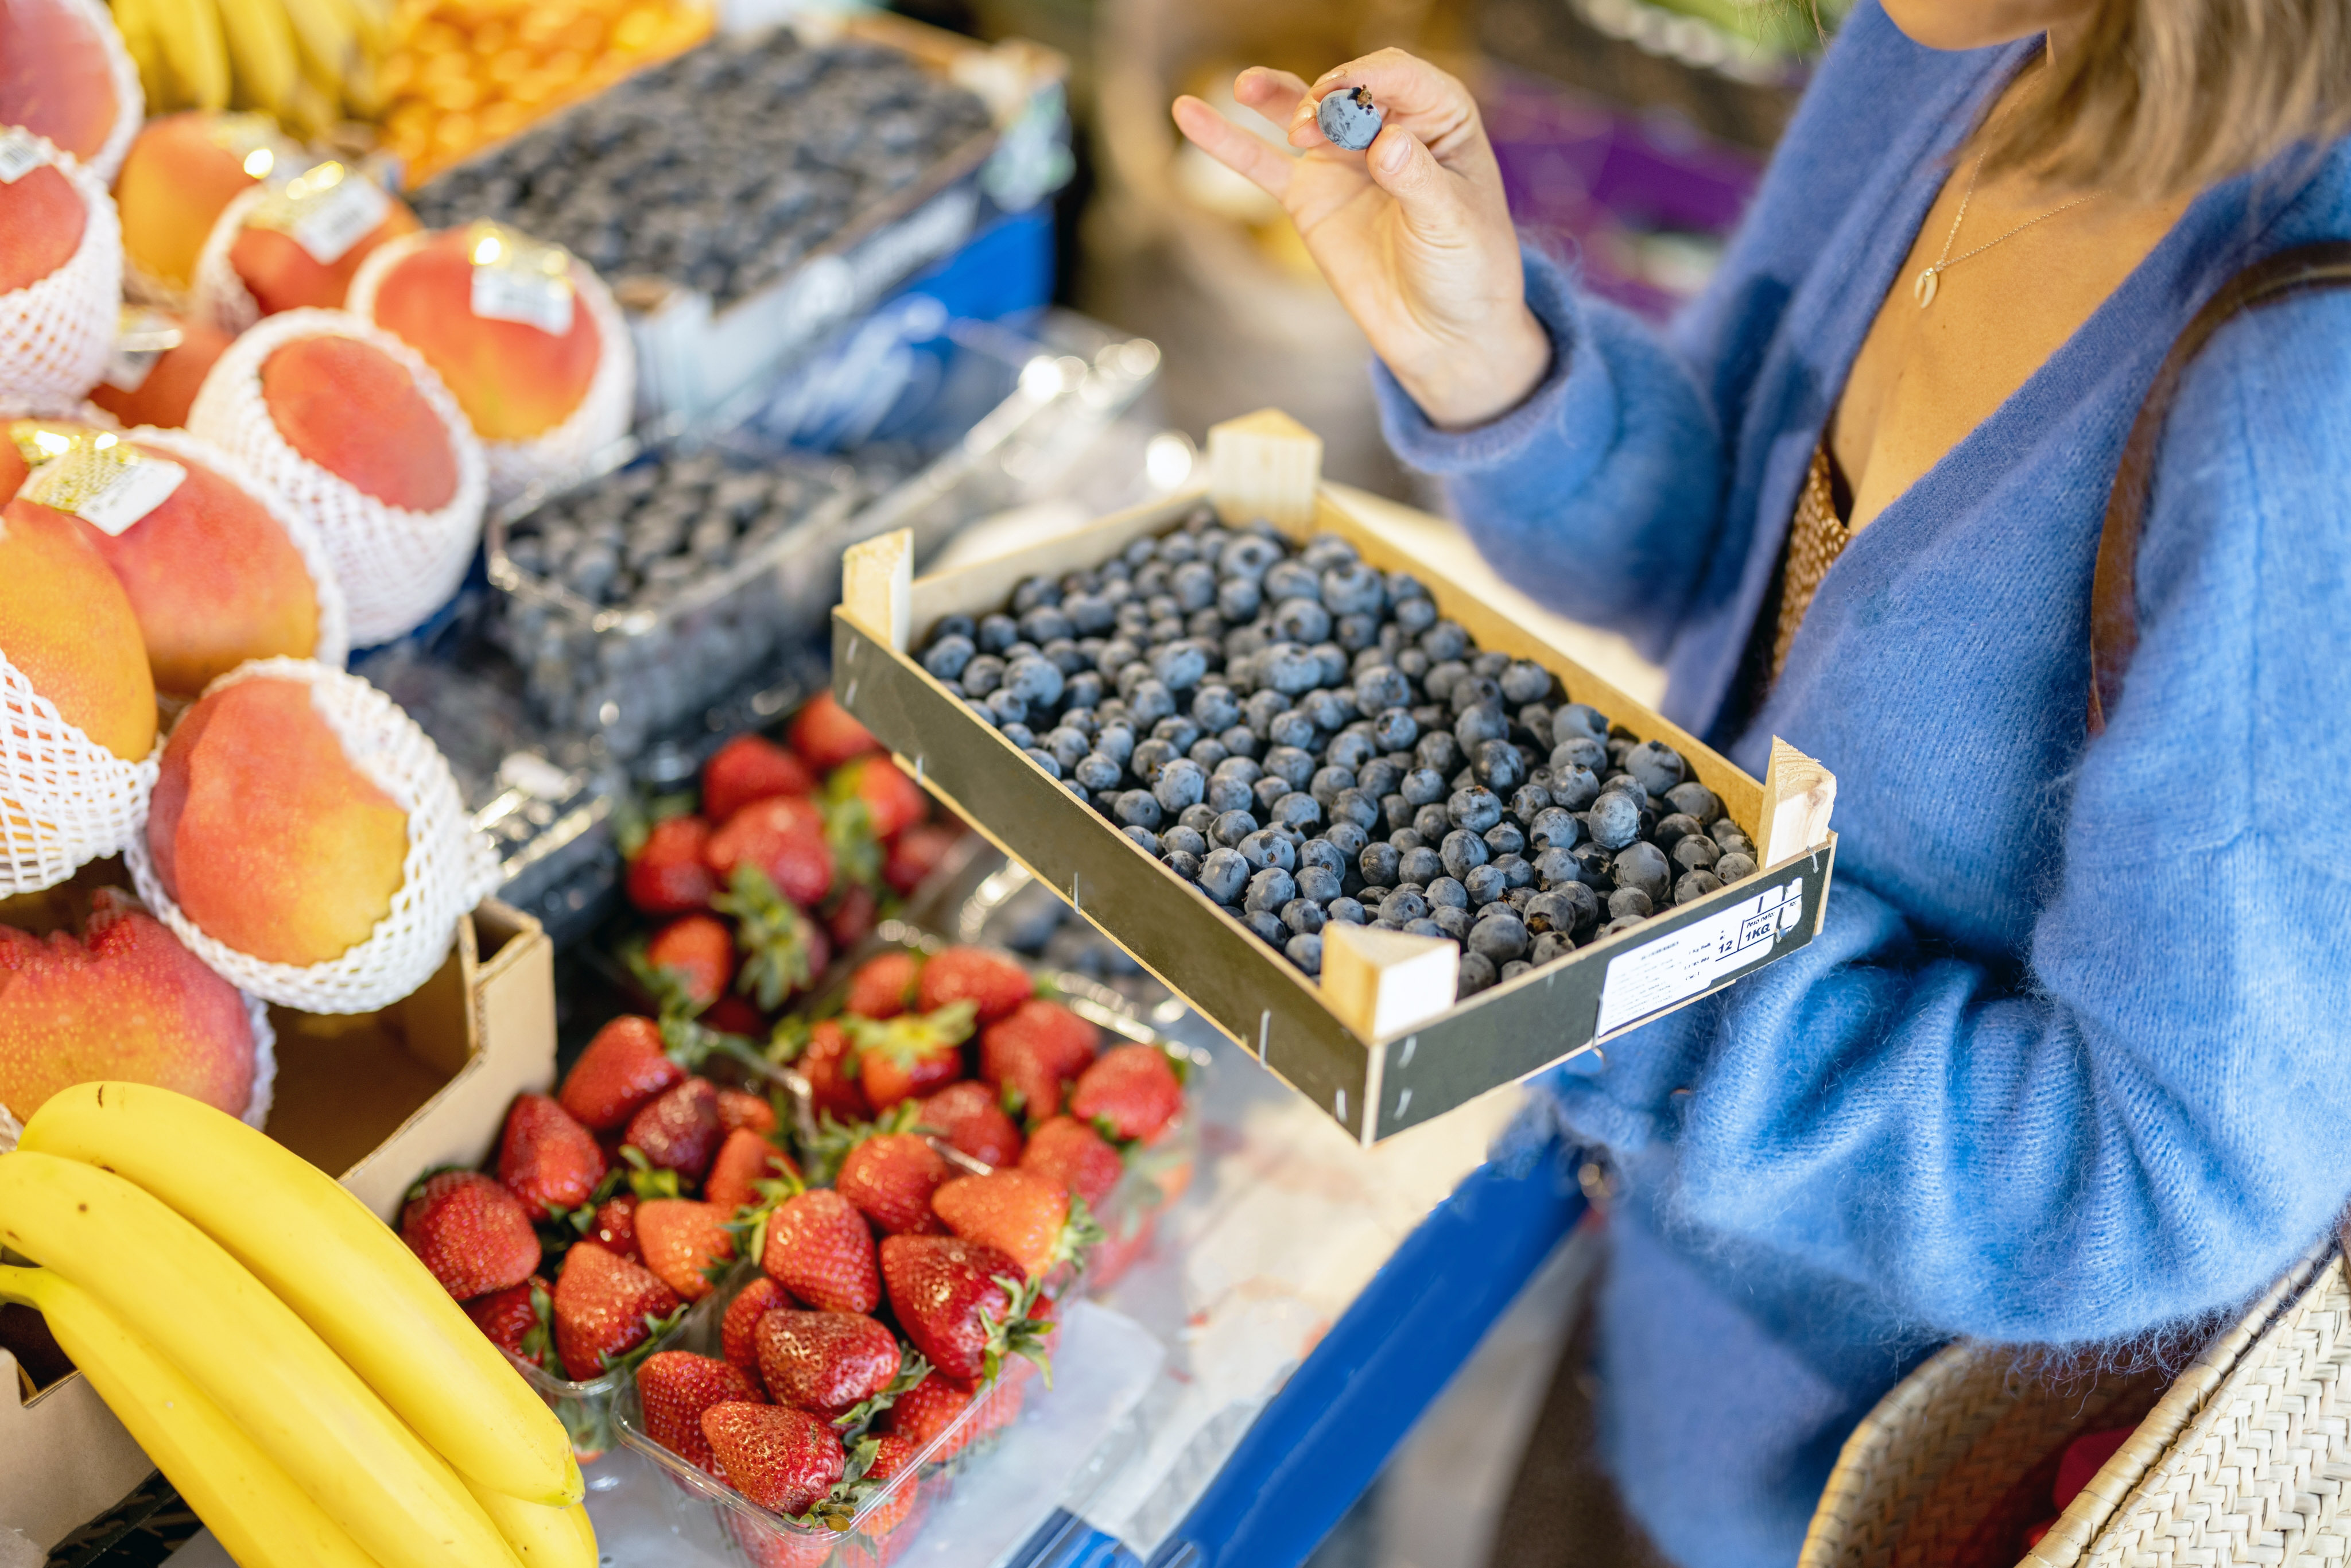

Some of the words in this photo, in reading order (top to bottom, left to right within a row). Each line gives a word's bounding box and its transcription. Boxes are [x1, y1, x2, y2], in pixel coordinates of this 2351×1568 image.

[1747, 919, 1760, 929] Peso
[1760, 911, 1775, 922] neto:
[1718, 940, 1733, 954] 12
